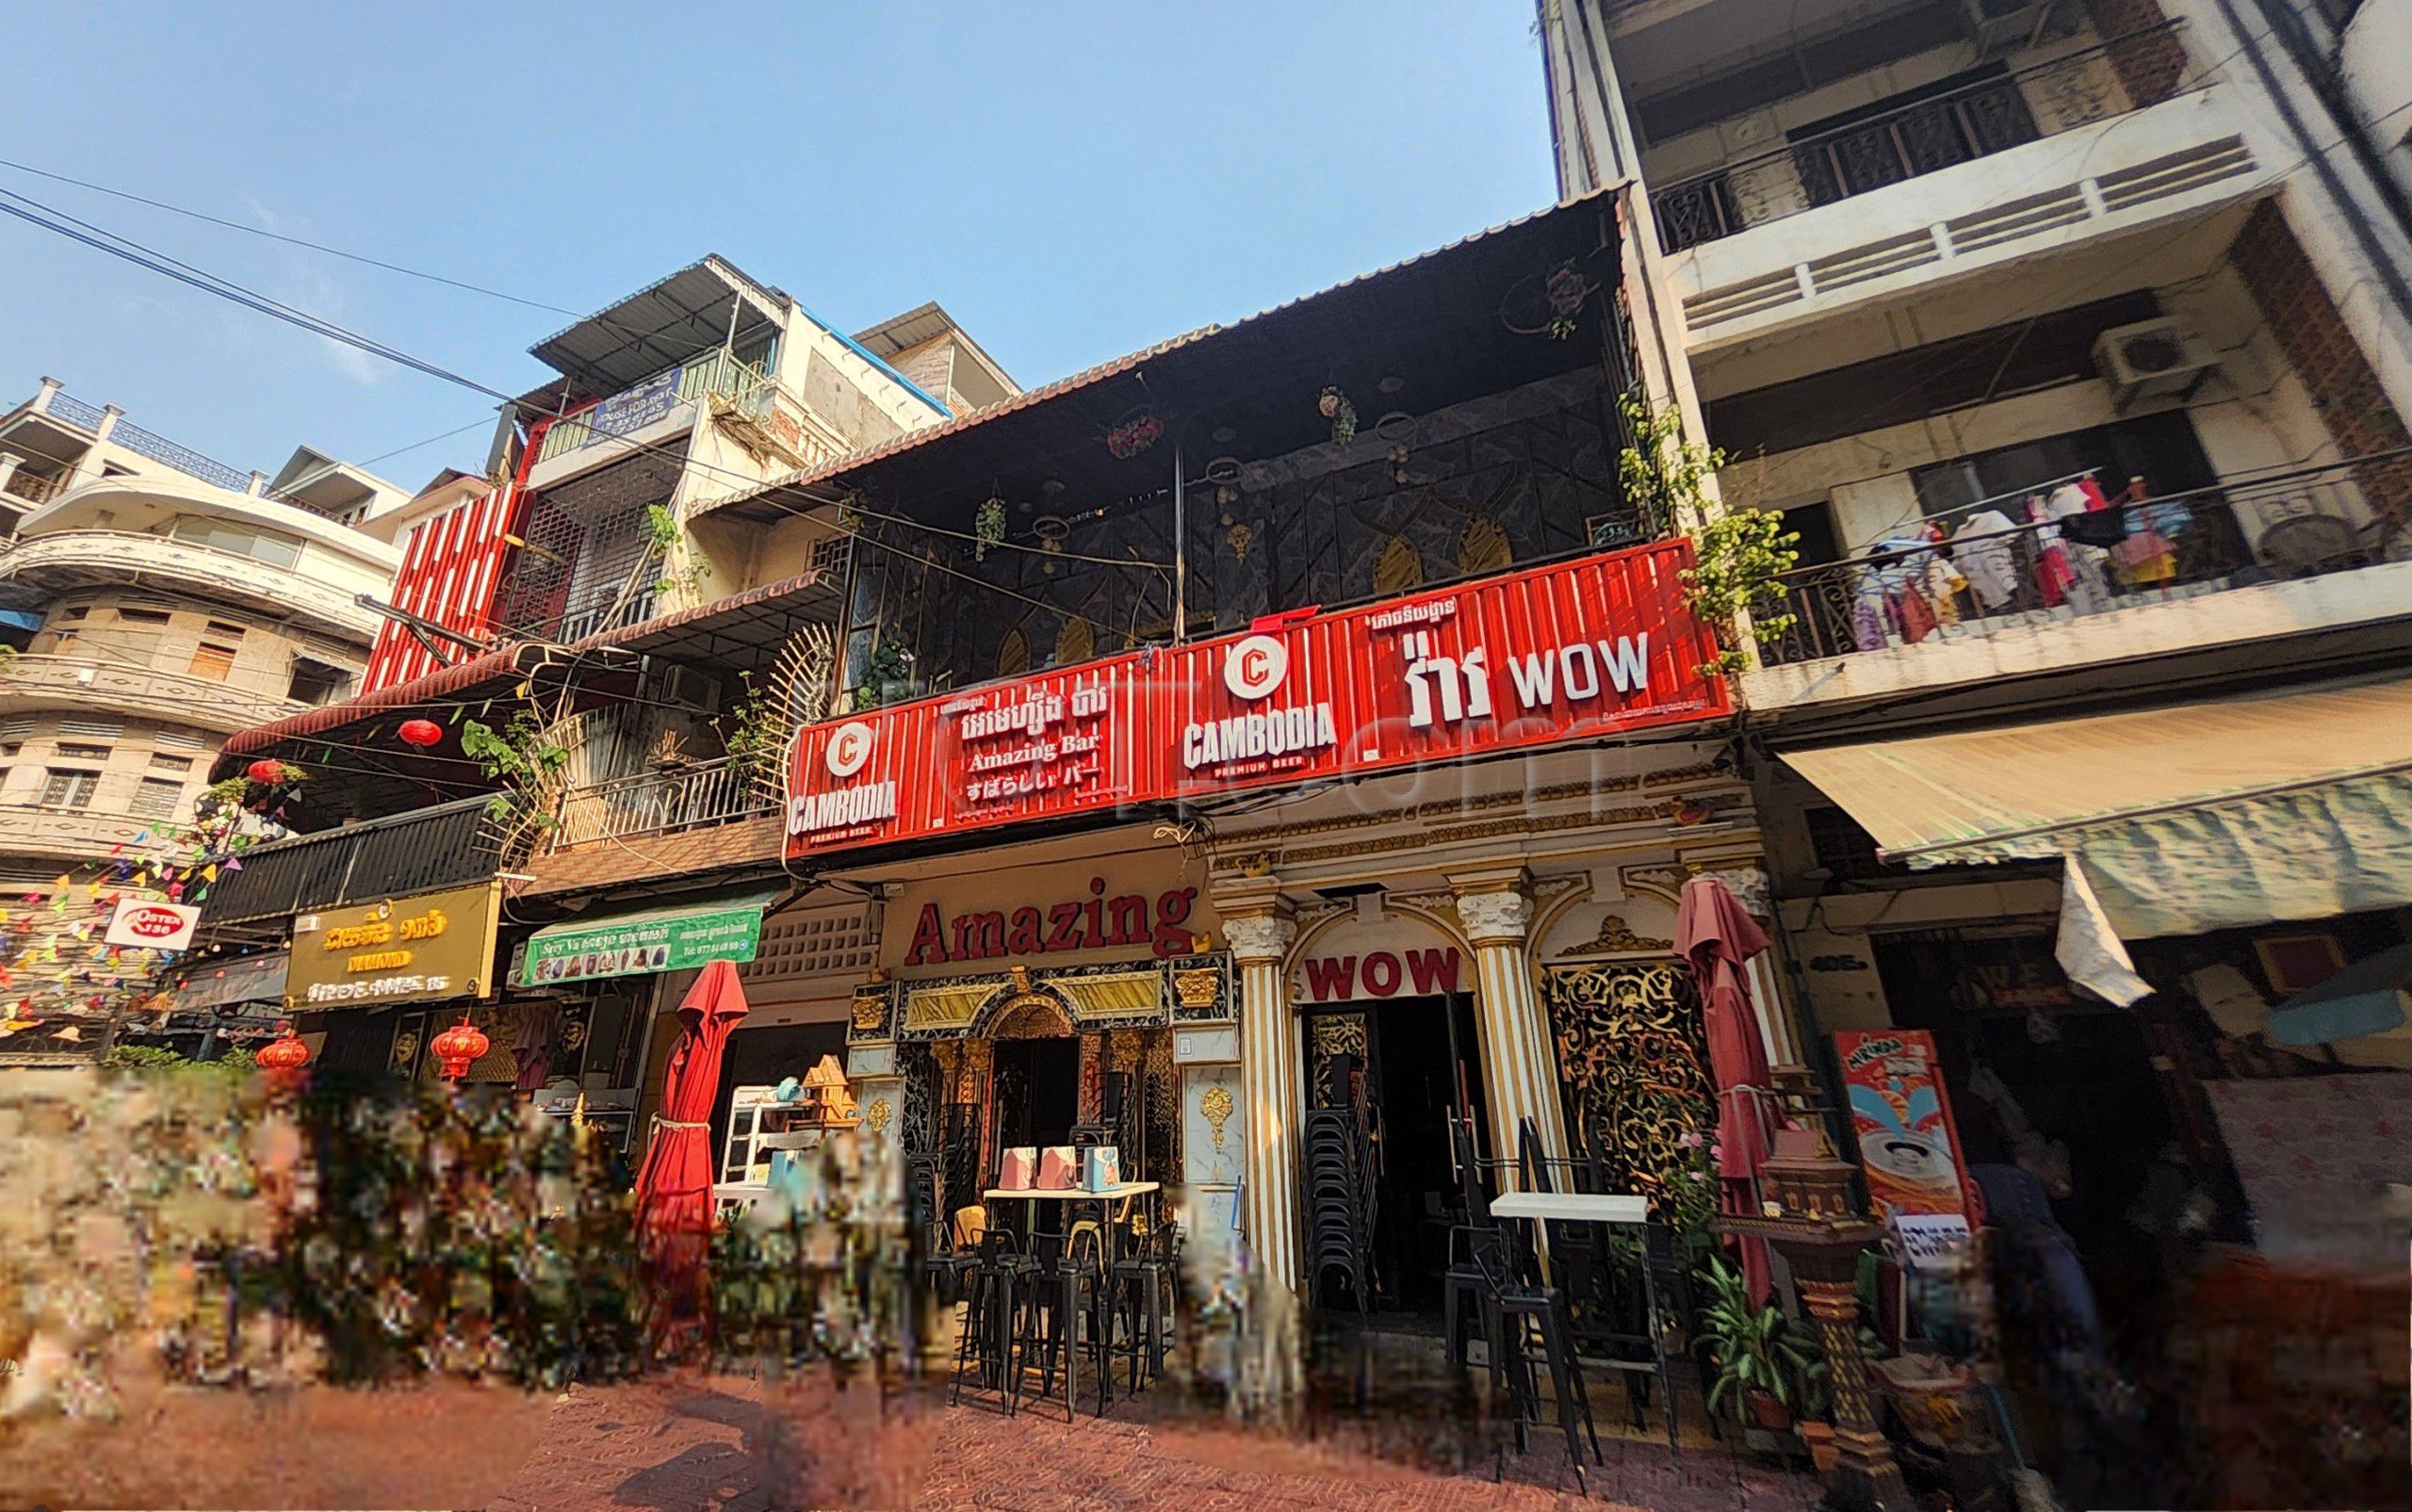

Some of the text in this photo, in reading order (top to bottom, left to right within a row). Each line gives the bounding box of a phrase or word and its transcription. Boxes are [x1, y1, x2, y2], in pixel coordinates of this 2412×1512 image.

[1509, 631, 1649, 708] WOW
[968, 734, 1100, 772] Amazing Bar
[1182, 702, 1337, 771] CAMBODIA
[966, 771, 1056, 802] すばらしい
[1214, 756, 1306, 778] PREMIUM BEER
[790, 780, 897, 837] CAMBODIA
[903, 876, 1198, 967] Amazing
[346, 950, 413, 972] DIAMOND
[1304, 945, 1461, 1001] WOW
